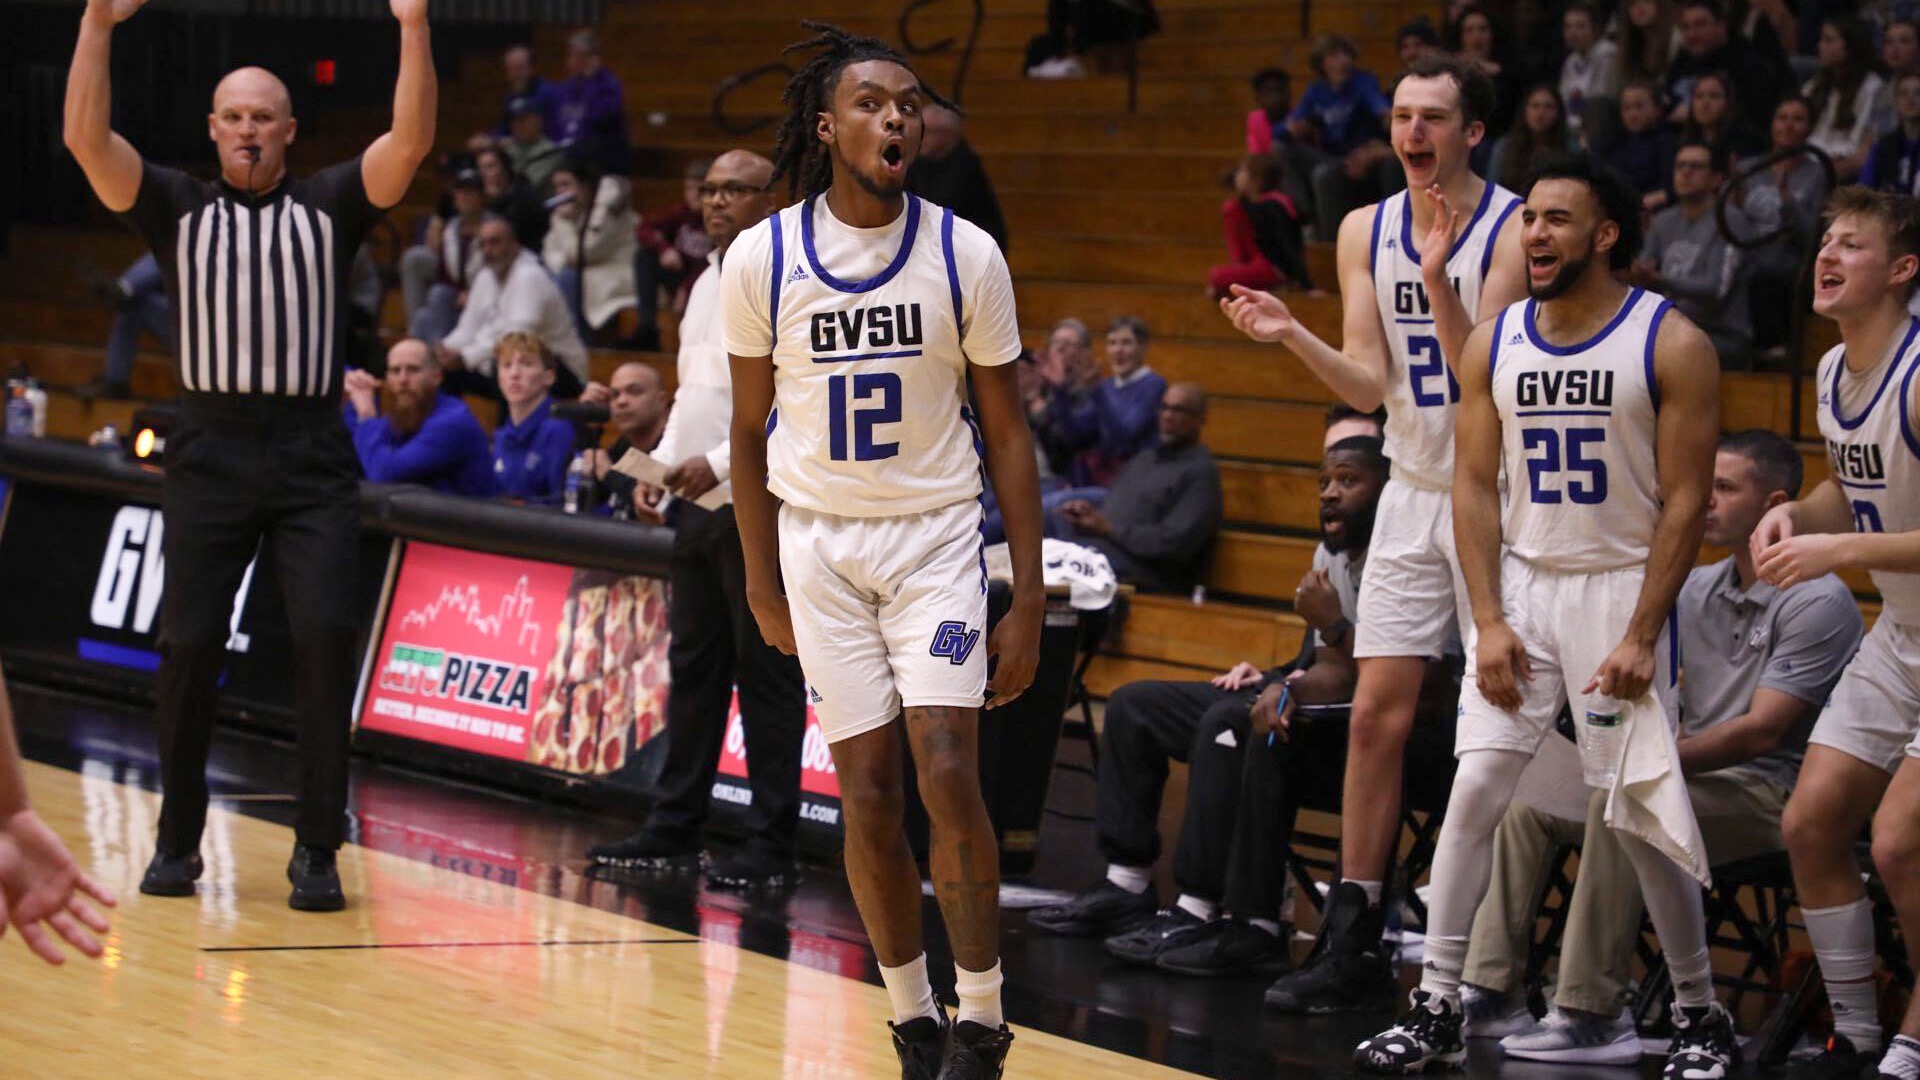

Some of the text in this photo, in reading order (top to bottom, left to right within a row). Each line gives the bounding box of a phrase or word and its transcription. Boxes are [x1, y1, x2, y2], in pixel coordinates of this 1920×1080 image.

[810, 303, 923, 352] GVSU
[1516, 370, 1615, 407] GVSU
[828, 372, 903, 462] 12
[1522, 427, 1609, 505] 25
[929, 620, 981, 666] GV
[439, 656, 533, 711] PIZZA
